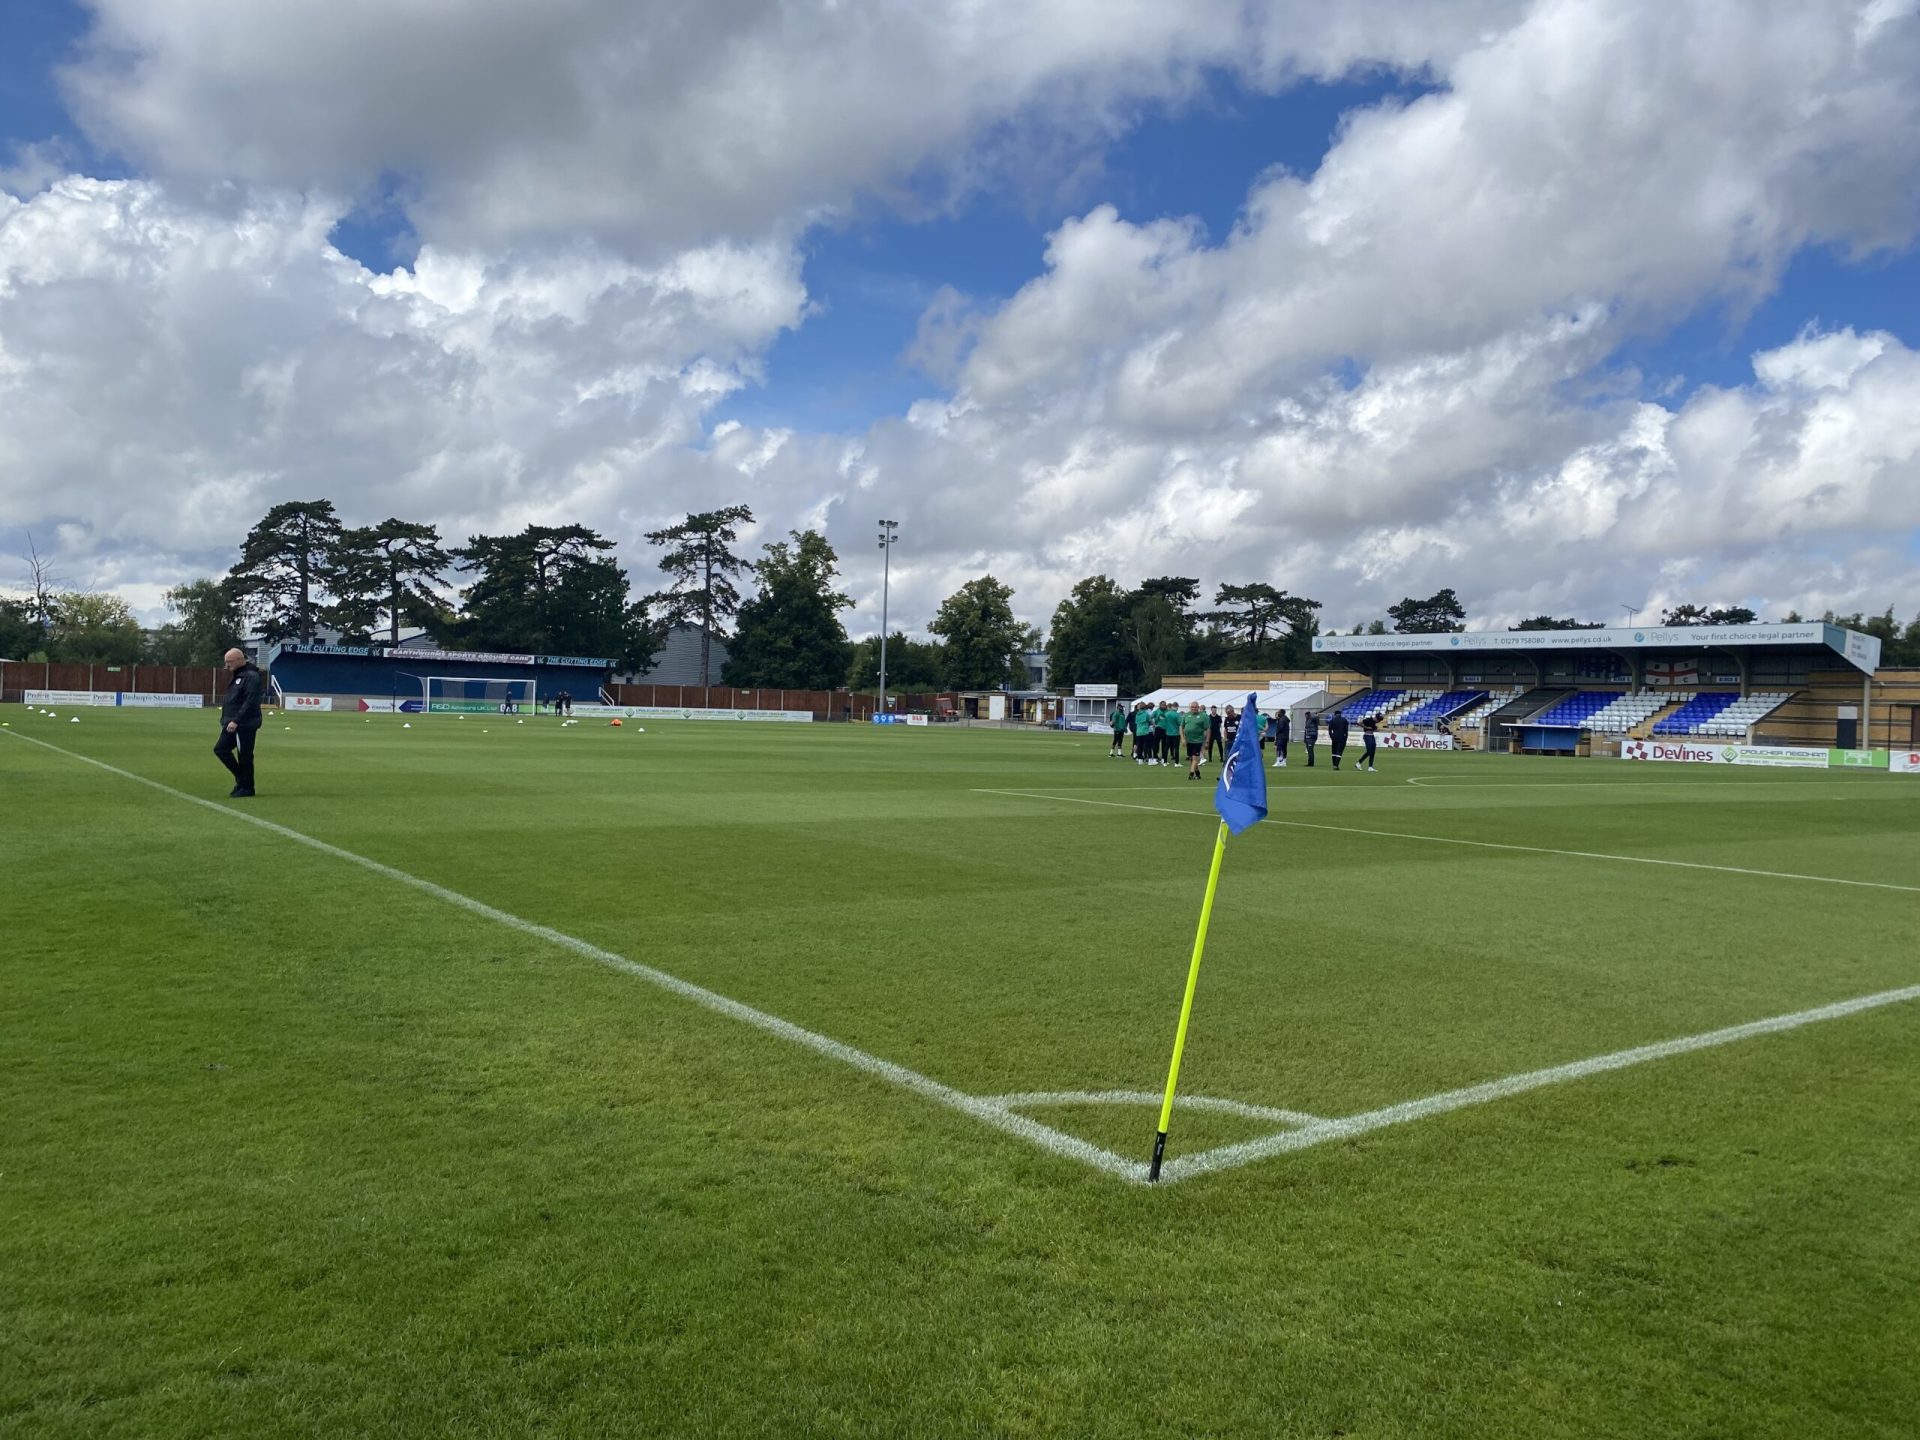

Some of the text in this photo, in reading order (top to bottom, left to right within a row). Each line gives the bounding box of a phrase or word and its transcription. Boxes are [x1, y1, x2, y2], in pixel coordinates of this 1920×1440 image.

[1463, 636, 1487, 646] Pellys
[1650, 630, 1815, 643] Pellys Your first choice legal partner
[296, 644, 369, 654] THE CUTTING EDGE
[1411, 640, 1433, 649] partner
[561, 657, 589, 665] CUTTING
[589, 658, 608, 666] EDGE
[297, 698, 320, 706] D&B
[1403, 734, 1448, 750] DeVines
[1652, 743, 1714, 761] DeVines
